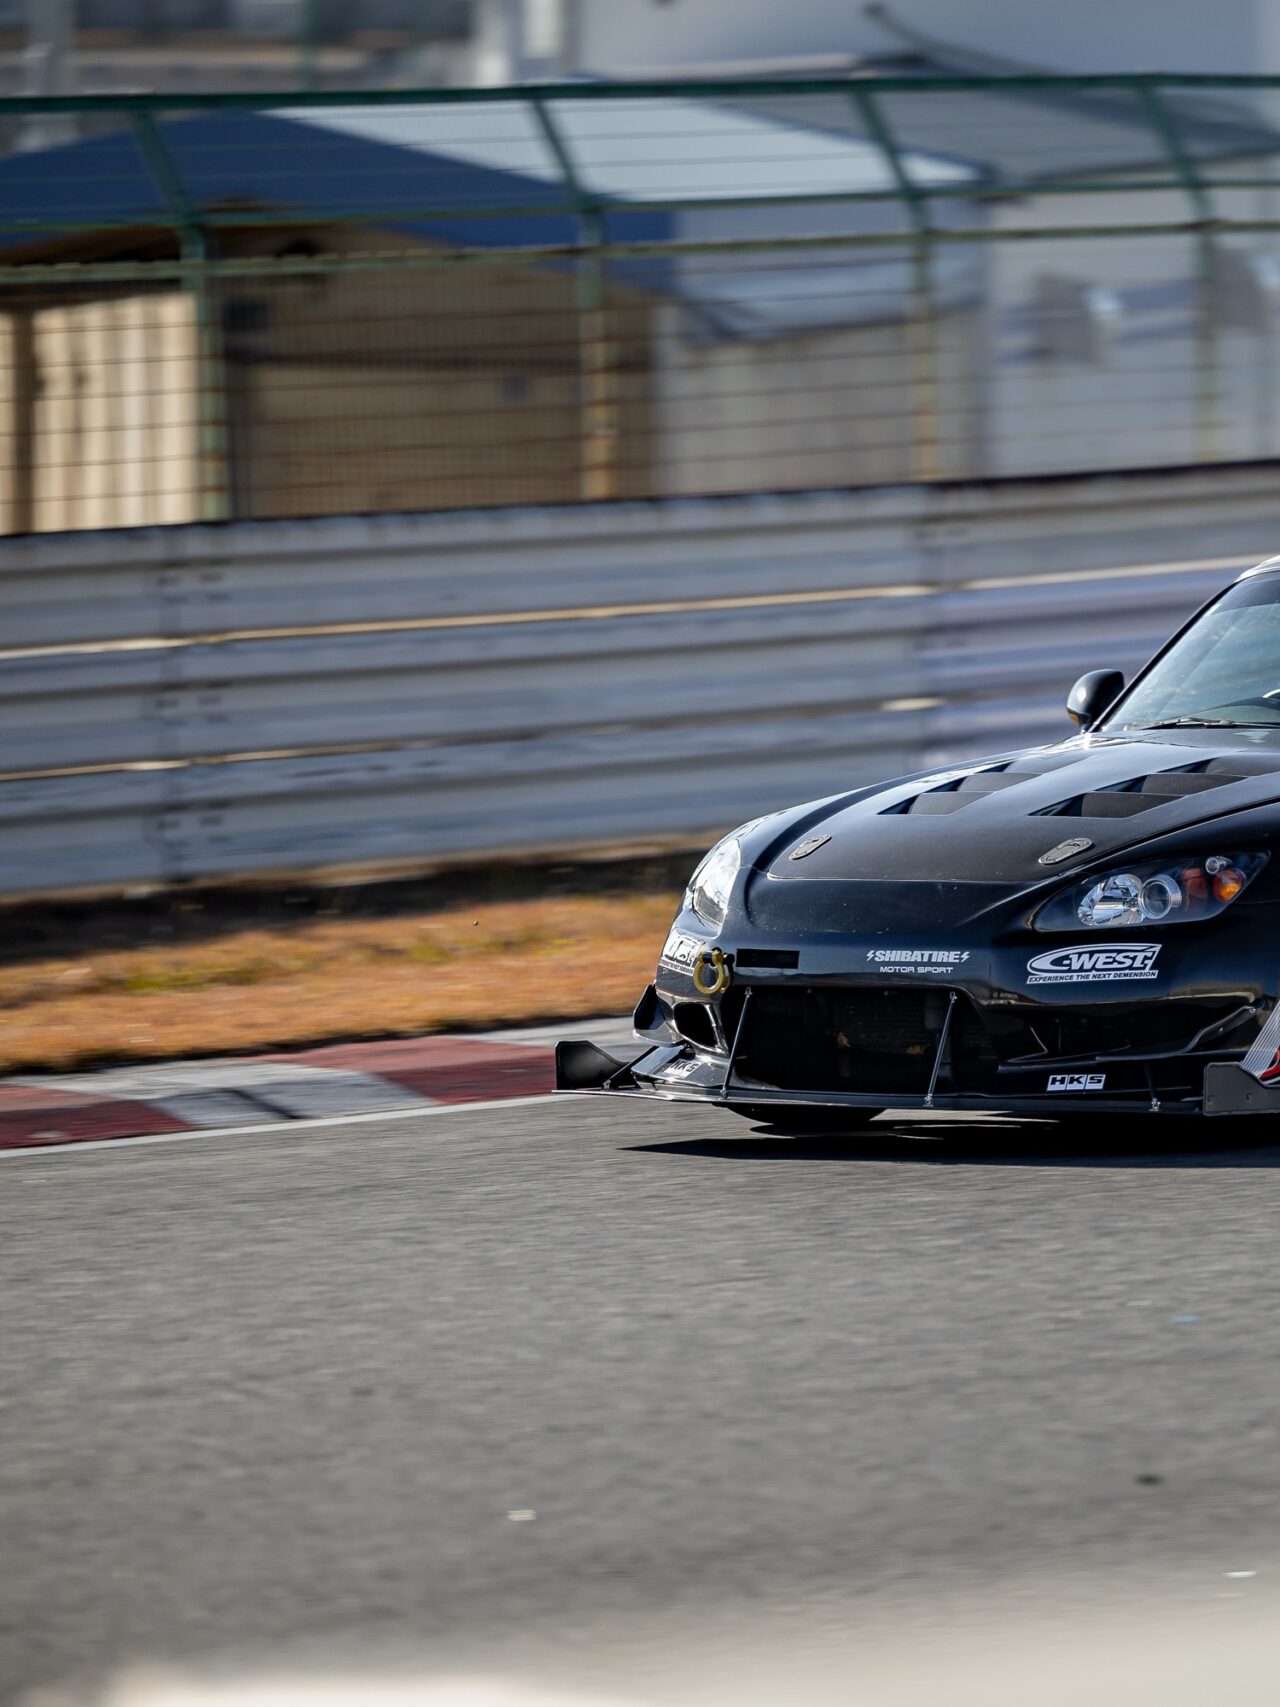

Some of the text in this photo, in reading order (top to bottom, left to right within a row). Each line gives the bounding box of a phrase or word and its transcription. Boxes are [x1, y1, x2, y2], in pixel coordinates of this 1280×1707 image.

[874, 950, 961, 963] SHIBATIRE
[1028, 943, 1160, 972] C-WEST
[1028, 971, 1157, 983] EXPERIENCE THE NEXT DEMENSION
[1049, 1075, 1105, 1087] HKS
